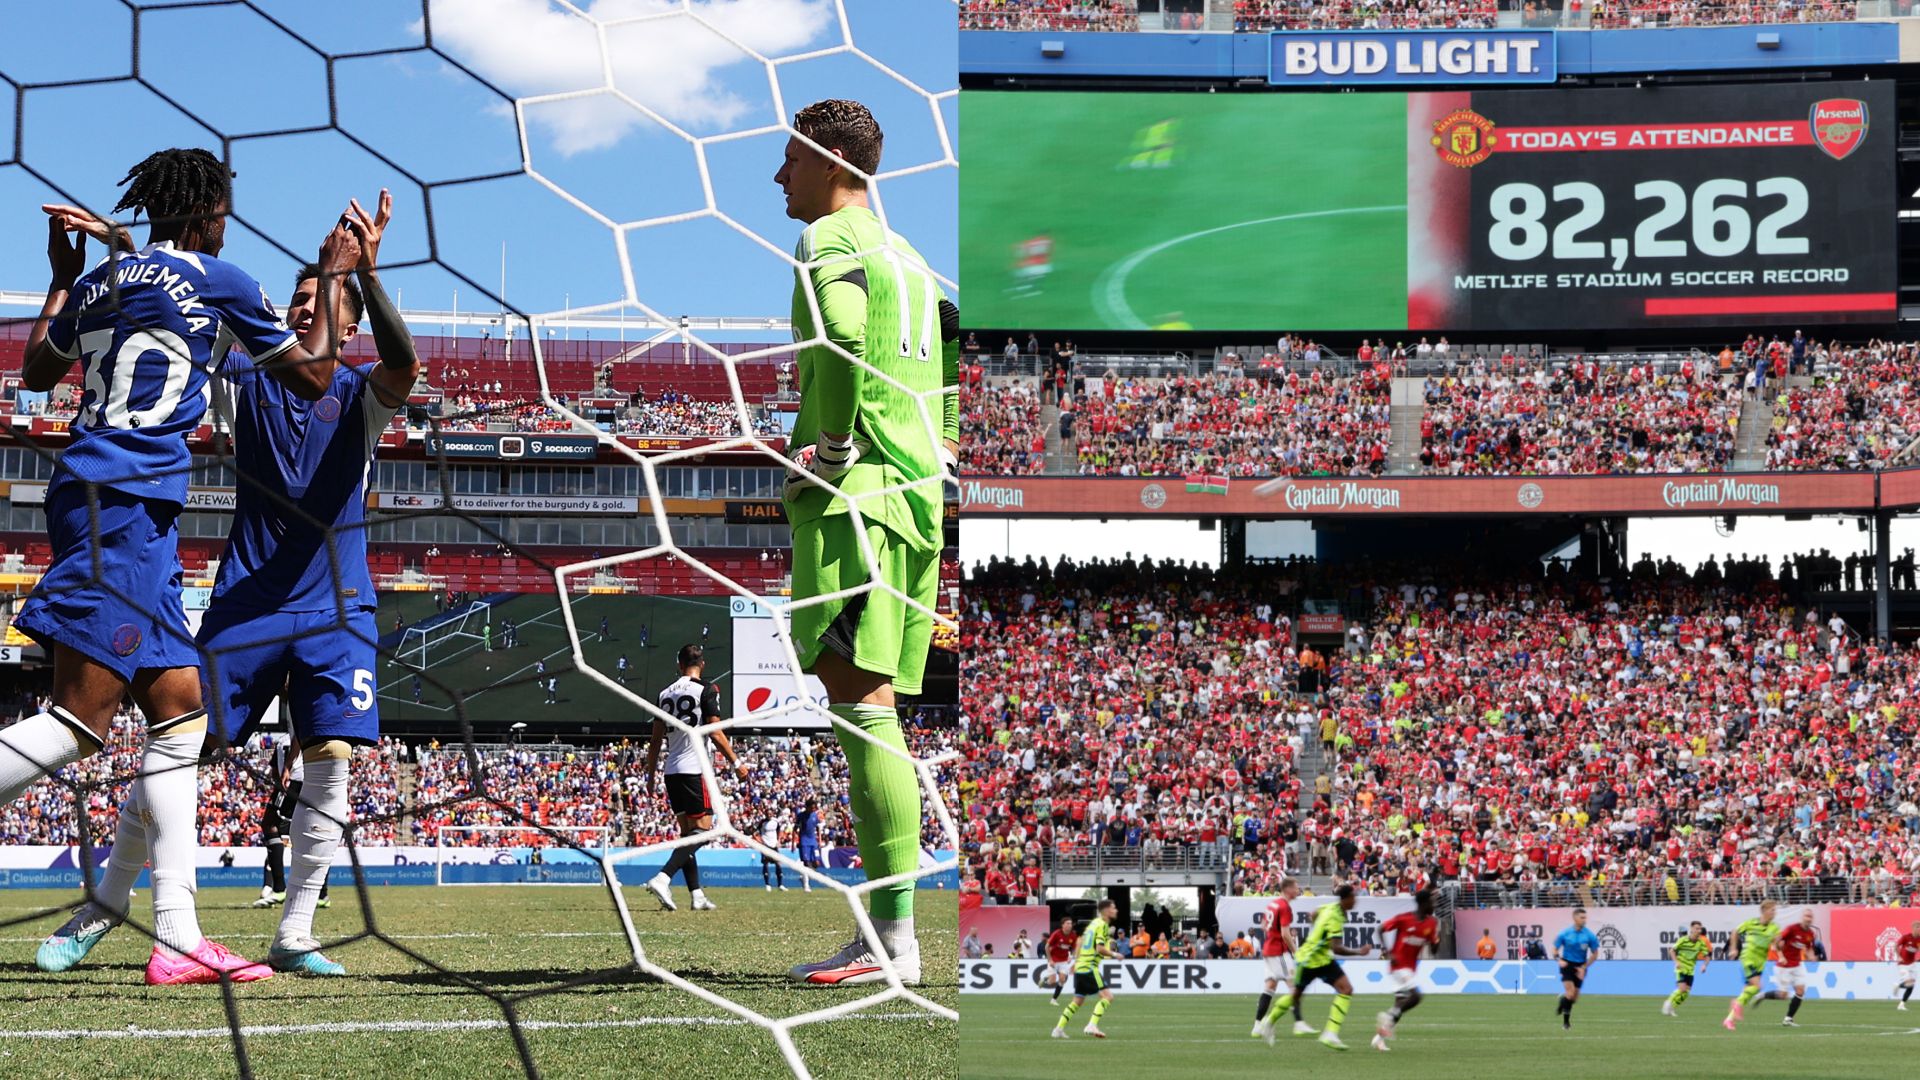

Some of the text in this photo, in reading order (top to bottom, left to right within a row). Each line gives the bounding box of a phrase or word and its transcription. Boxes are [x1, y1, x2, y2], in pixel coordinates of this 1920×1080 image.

[1285, 41, 1388, 75] BUD
[1438, 113, 1491, 134] MANCHESTER
[1817, 108, 1861, 119] Arsenal
[1506, 126, 1794, 148] TODAY'S ATTENDANCE
[1446, 153, 1484, 165] UNITED
[1488, 177, 1810, 271] 82,262
[1454, 268, 1849, 289] METLIFE STADIUM SOCCER RECORD
[79, 327, 192, 429] 30
[393, 495, 422, 506] FedEx
[964, 482, 1023, 508] Morgan
[1285, 482, 1400, 510] Captain Morgan
[1663, 478, 1779, 508] Captain Morgan
[464, 499, 473, 507] to
[475, 499, 509, 508] deliver
[511, 500, 524, 508] for
[527, 500, 543, 509] the
[545, 500, 590, 510] burgundy
[592, 501, 600, 509] &
[602, 501, 625, 511] gold.
[742, 505, 780, 517] HAIL
[751, 602, 757, 614] 1
[351, 668, 374, 711] 5
[1507, 925, 1543, 939] OLD
